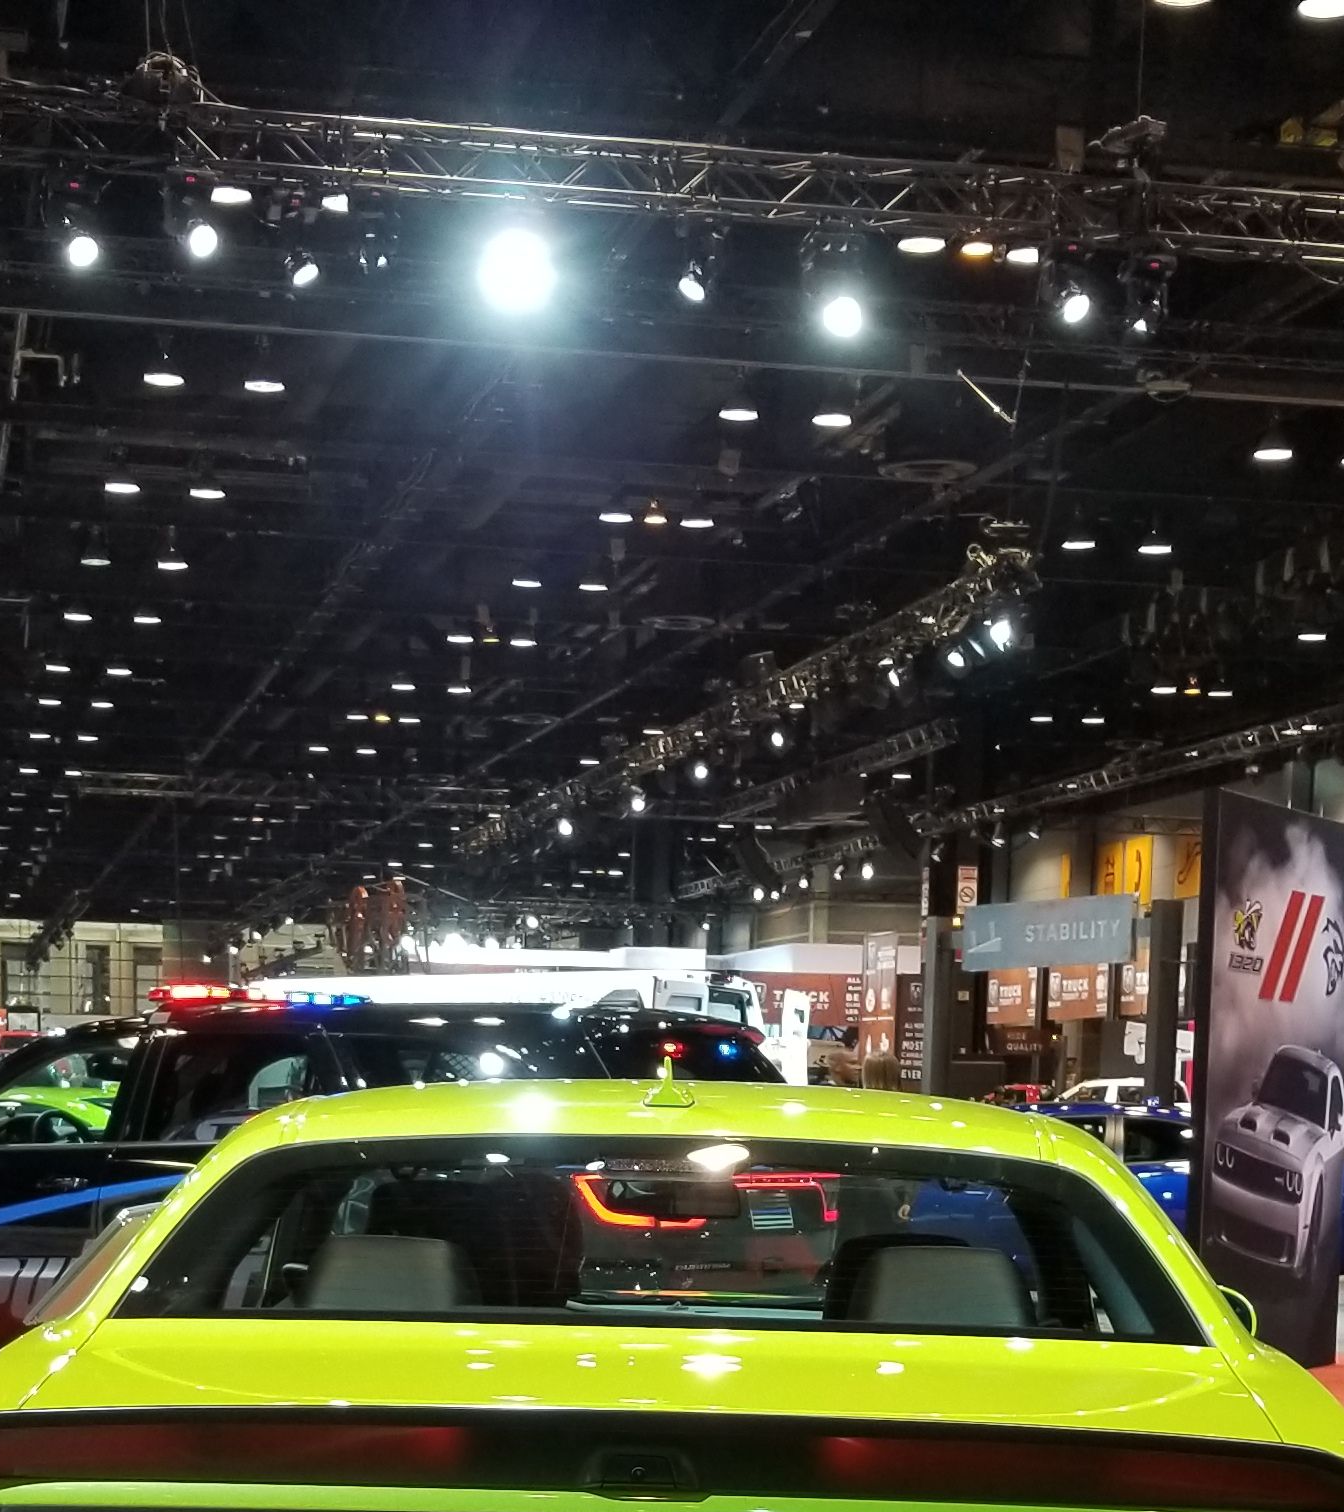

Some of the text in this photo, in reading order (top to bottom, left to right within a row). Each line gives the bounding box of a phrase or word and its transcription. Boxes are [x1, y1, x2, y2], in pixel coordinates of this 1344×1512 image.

[1025, 919, 1120, 942] STABILITY
[1229, 953, 1264, 974] 1320
[1006, 1043, 1043, 1051] QUALITY
